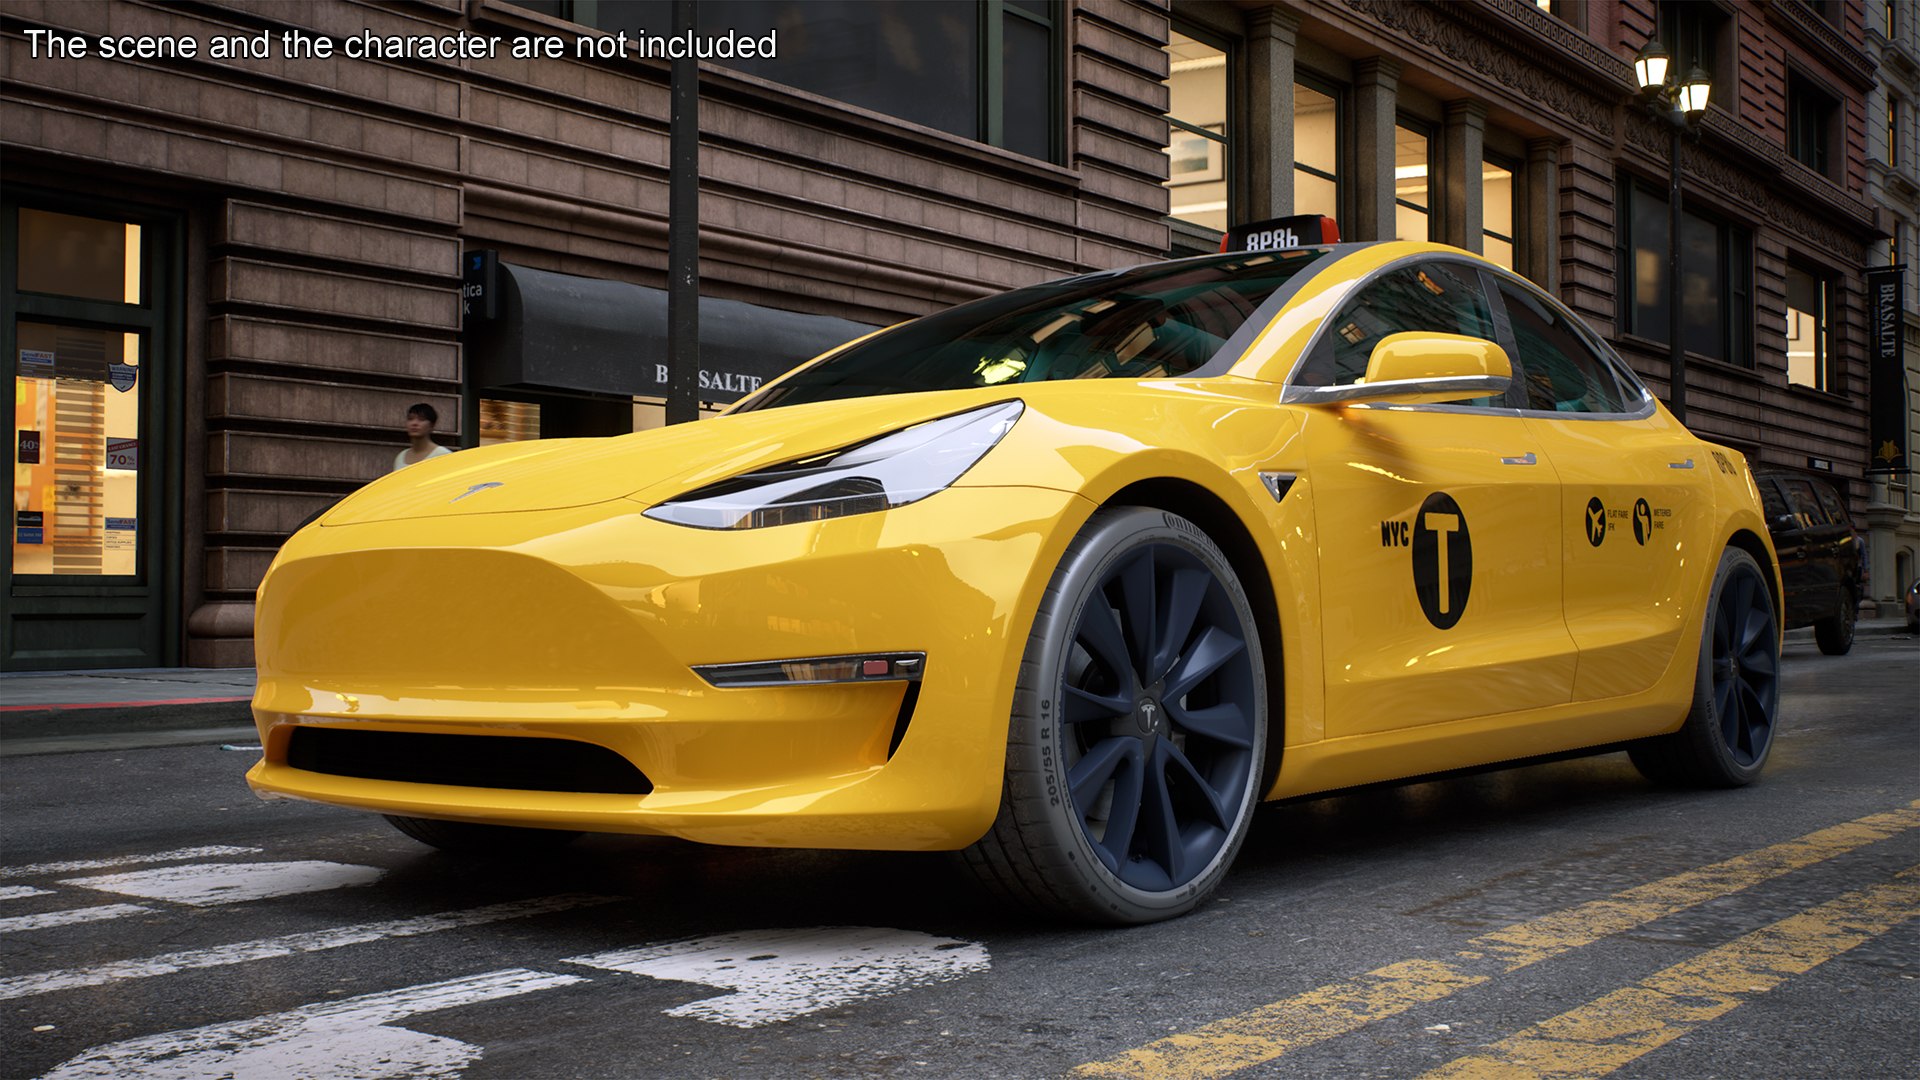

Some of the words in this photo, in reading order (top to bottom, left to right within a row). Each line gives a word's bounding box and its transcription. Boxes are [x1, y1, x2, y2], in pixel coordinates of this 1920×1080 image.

[1881, 283, 1896, 358] BRASALTE
[1381, 520, 1409, 547] NYC
[1424, 511, 1459, 614] T
[1041, 699, 1050, 721] 16
[1041, 727, 1050, 740] R
[1042, 746, 1060, 807] 205/55
